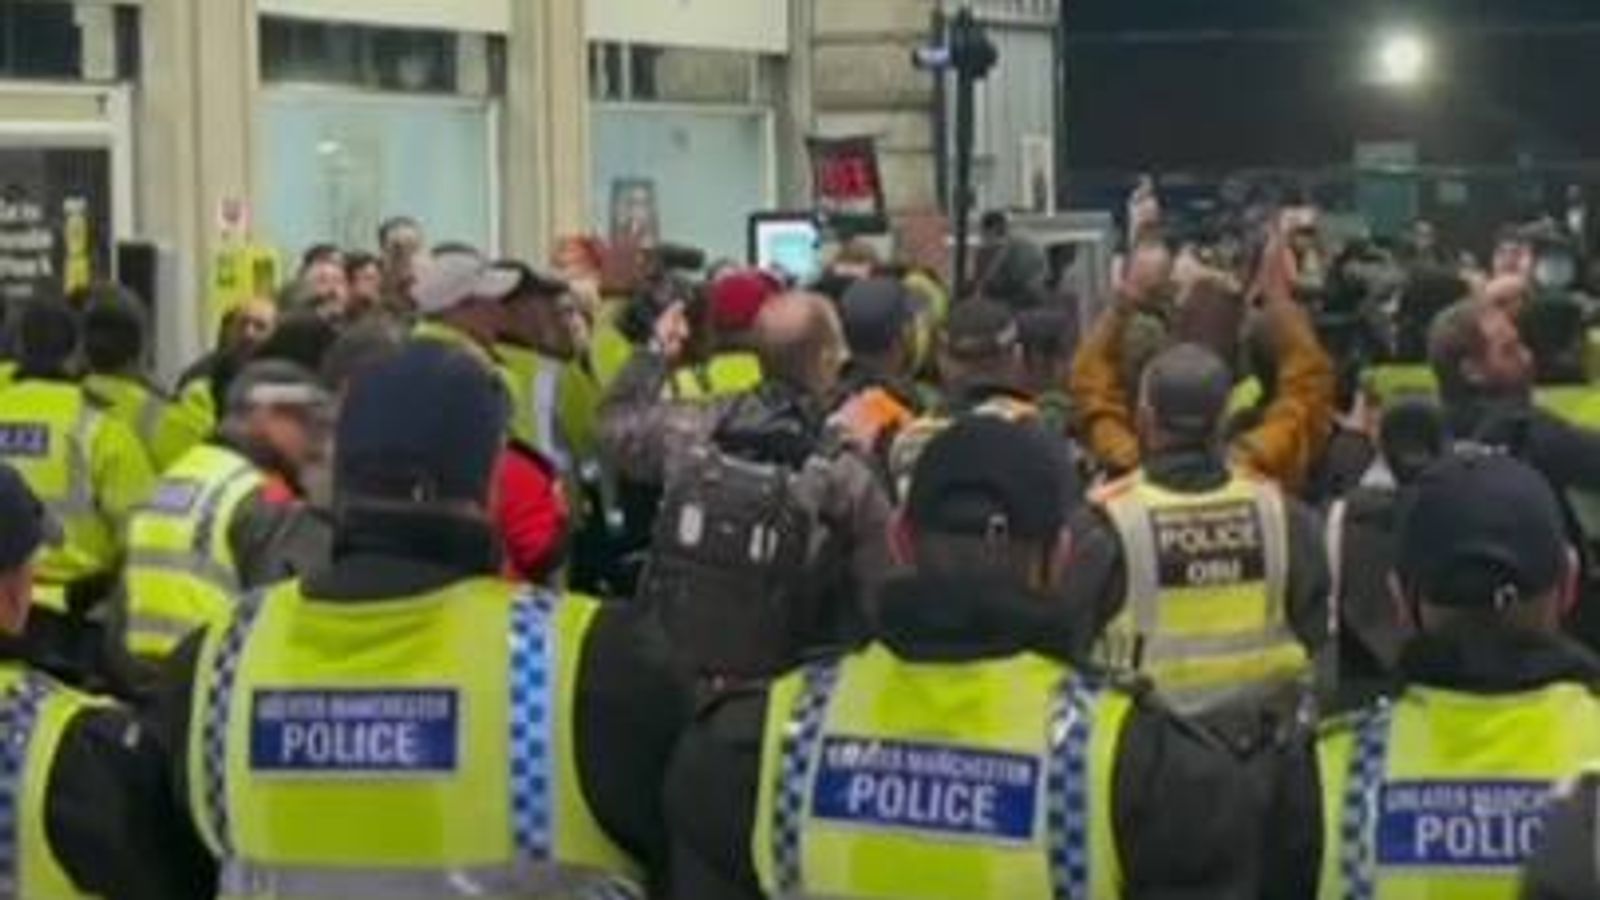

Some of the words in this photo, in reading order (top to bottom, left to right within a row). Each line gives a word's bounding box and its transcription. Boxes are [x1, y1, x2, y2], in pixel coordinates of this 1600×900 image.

[1160, 522, 1254, 554] POLICE
[281, 720, 420, 763] POLICE
[906, 752, 1032, 786] MANCHESTER
[847, 773, 998, 828] POLICE
[1387, 785, 1467, 811] GREATER
[1415, 816, 1546, 858] POLIC
